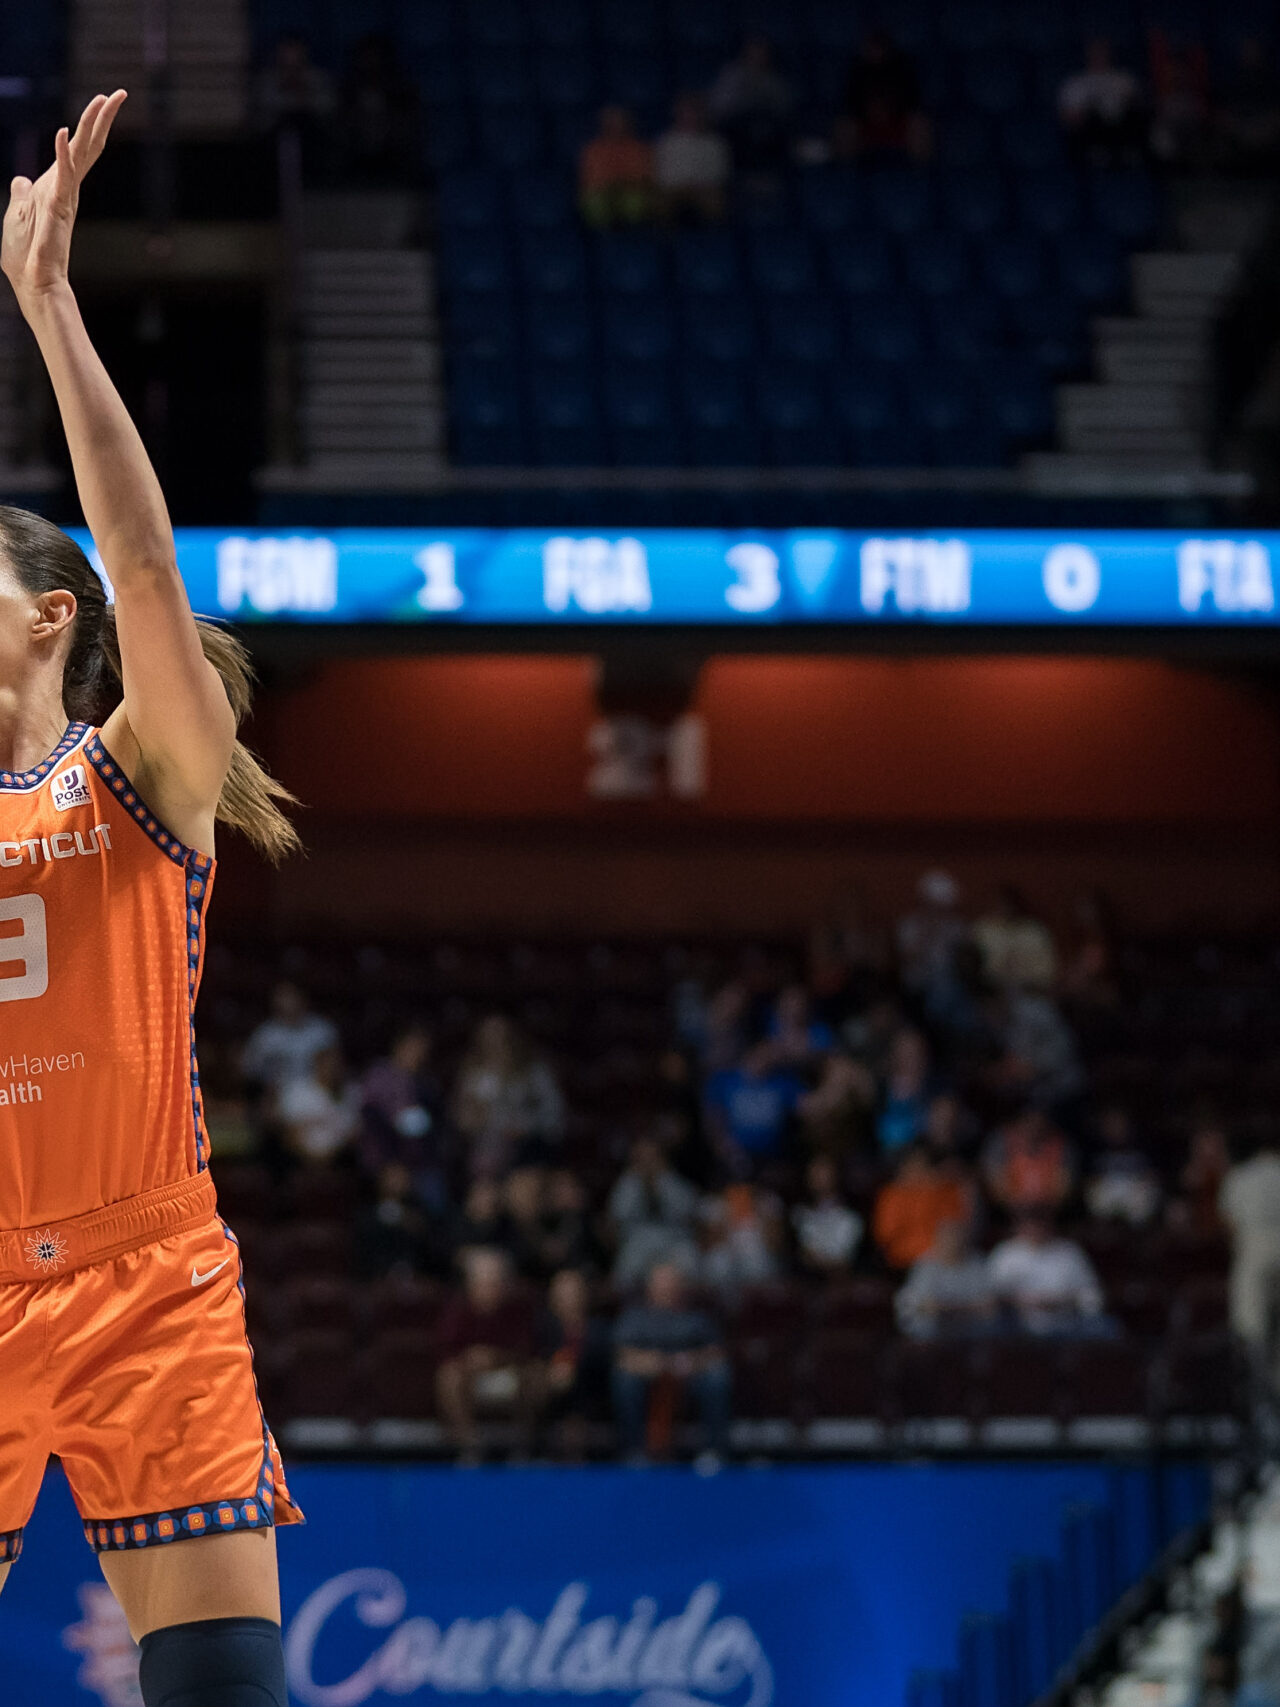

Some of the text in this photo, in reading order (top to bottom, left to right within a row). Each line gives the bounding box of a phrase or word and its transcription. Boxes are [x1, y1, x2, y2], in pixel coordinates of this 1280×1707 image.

[417, 542, 464, 611] 1
[724, 542, 782, 612] 3
[1042, 544, 1100, 612] 0
[586, 712, 708, 798] 21
[285, 1566, 774, 1706] Courtside
